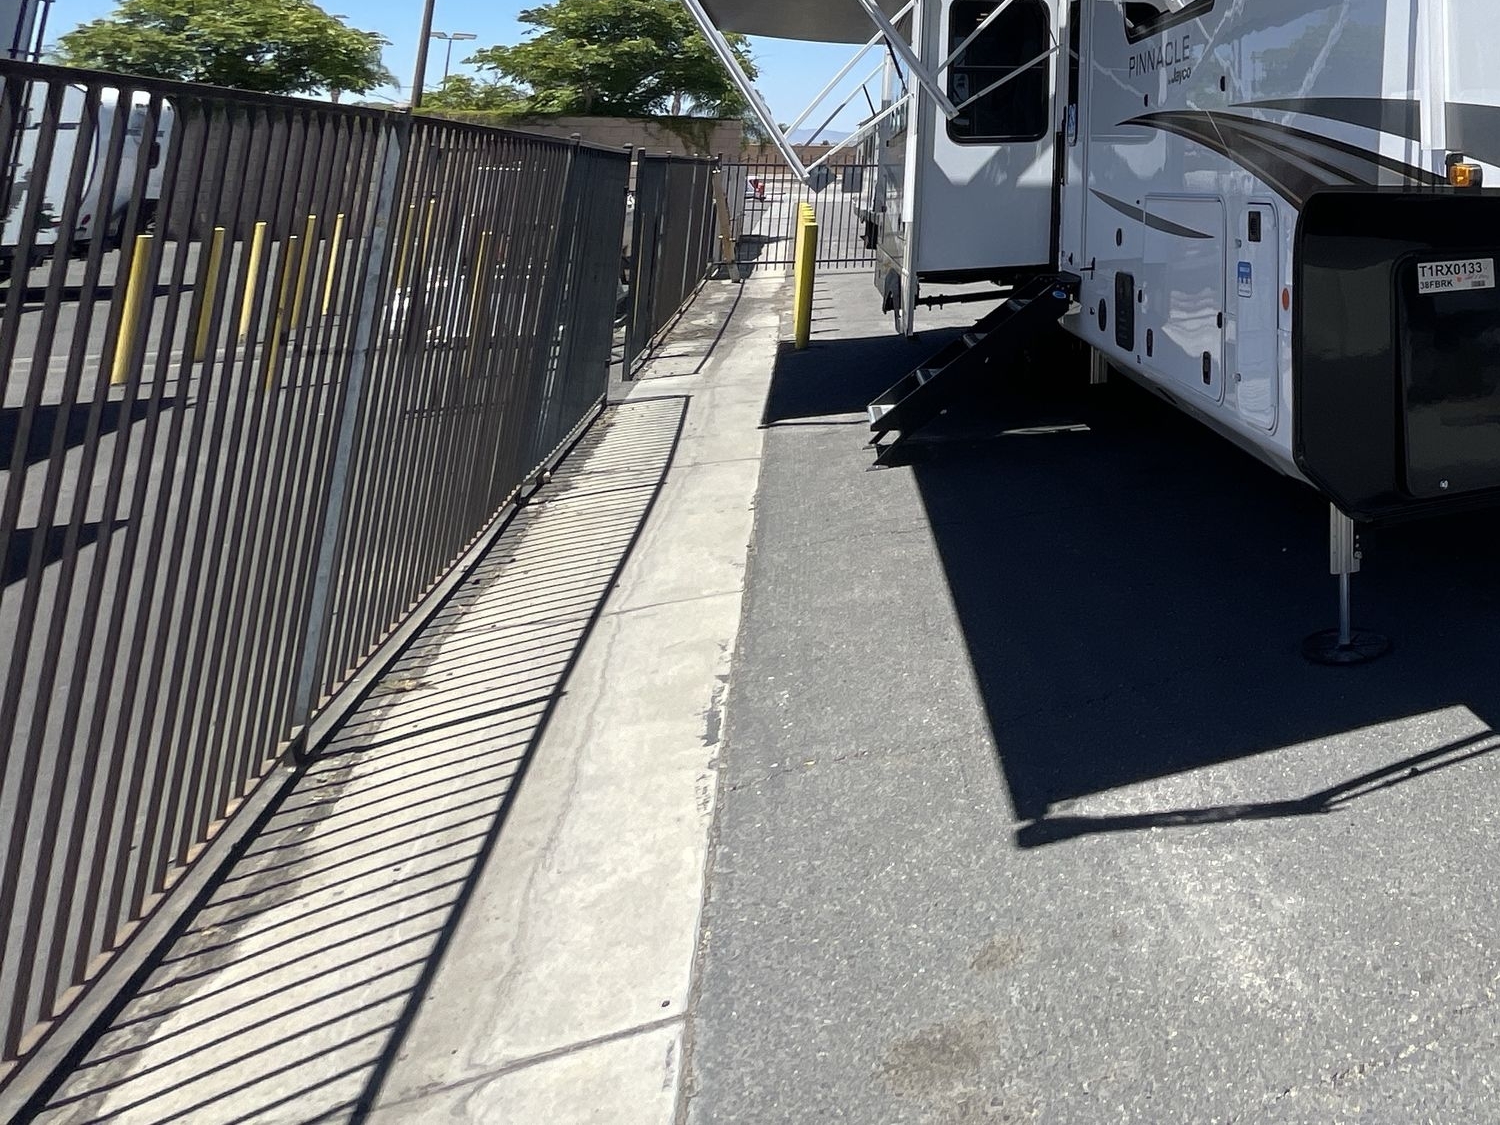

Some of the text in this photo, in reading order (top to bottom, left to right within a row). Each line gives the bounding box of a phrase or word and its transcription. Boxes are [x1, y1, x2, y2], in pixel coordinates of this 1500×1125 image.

[1128, 35, 1190, 79] PINNACLE
[1419, 262, 1482, 277] T1RX0133
[1420, 279, 1454, 290] 38FBRK
